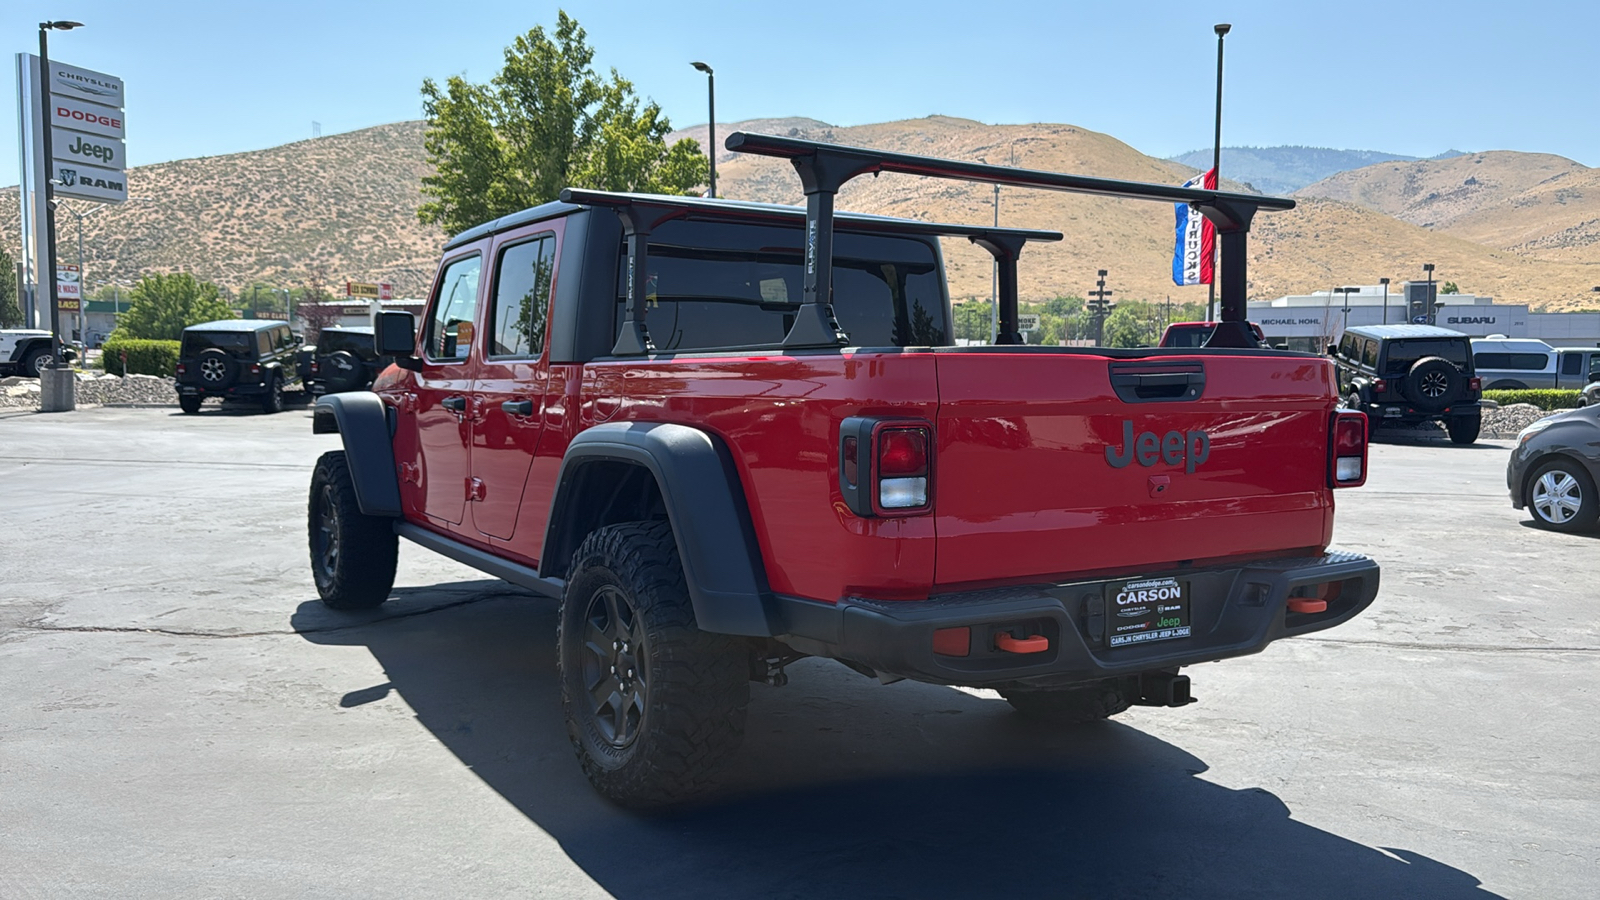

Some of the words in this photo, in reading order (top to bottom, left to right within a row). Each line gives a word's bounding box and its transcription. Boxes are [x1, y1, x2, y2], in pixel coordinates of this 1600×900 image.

[58, 71, 119, 90] CHRYSLER
[57, 106, 121, 128] DODGE
[69, 136, 114, 163] Jeep
[79, 176, 123, 191] RAM
[63, 285, 78, 293] WASH
[1447, 316, 1496, 325] SUBARU
[1105, 419, 1210, 474] Jeep
[1127, 580, 1173, 589] carsondodge.com
[1116, 586, 1181, 605] CARSON
[1116, 623, 1147, 631] DODGE
[1156, 616, 1180, 628] Jeep
[1132, 632, 1158, 642] CHRYSLER
[1159, 630, 1172, 638] JEEP
